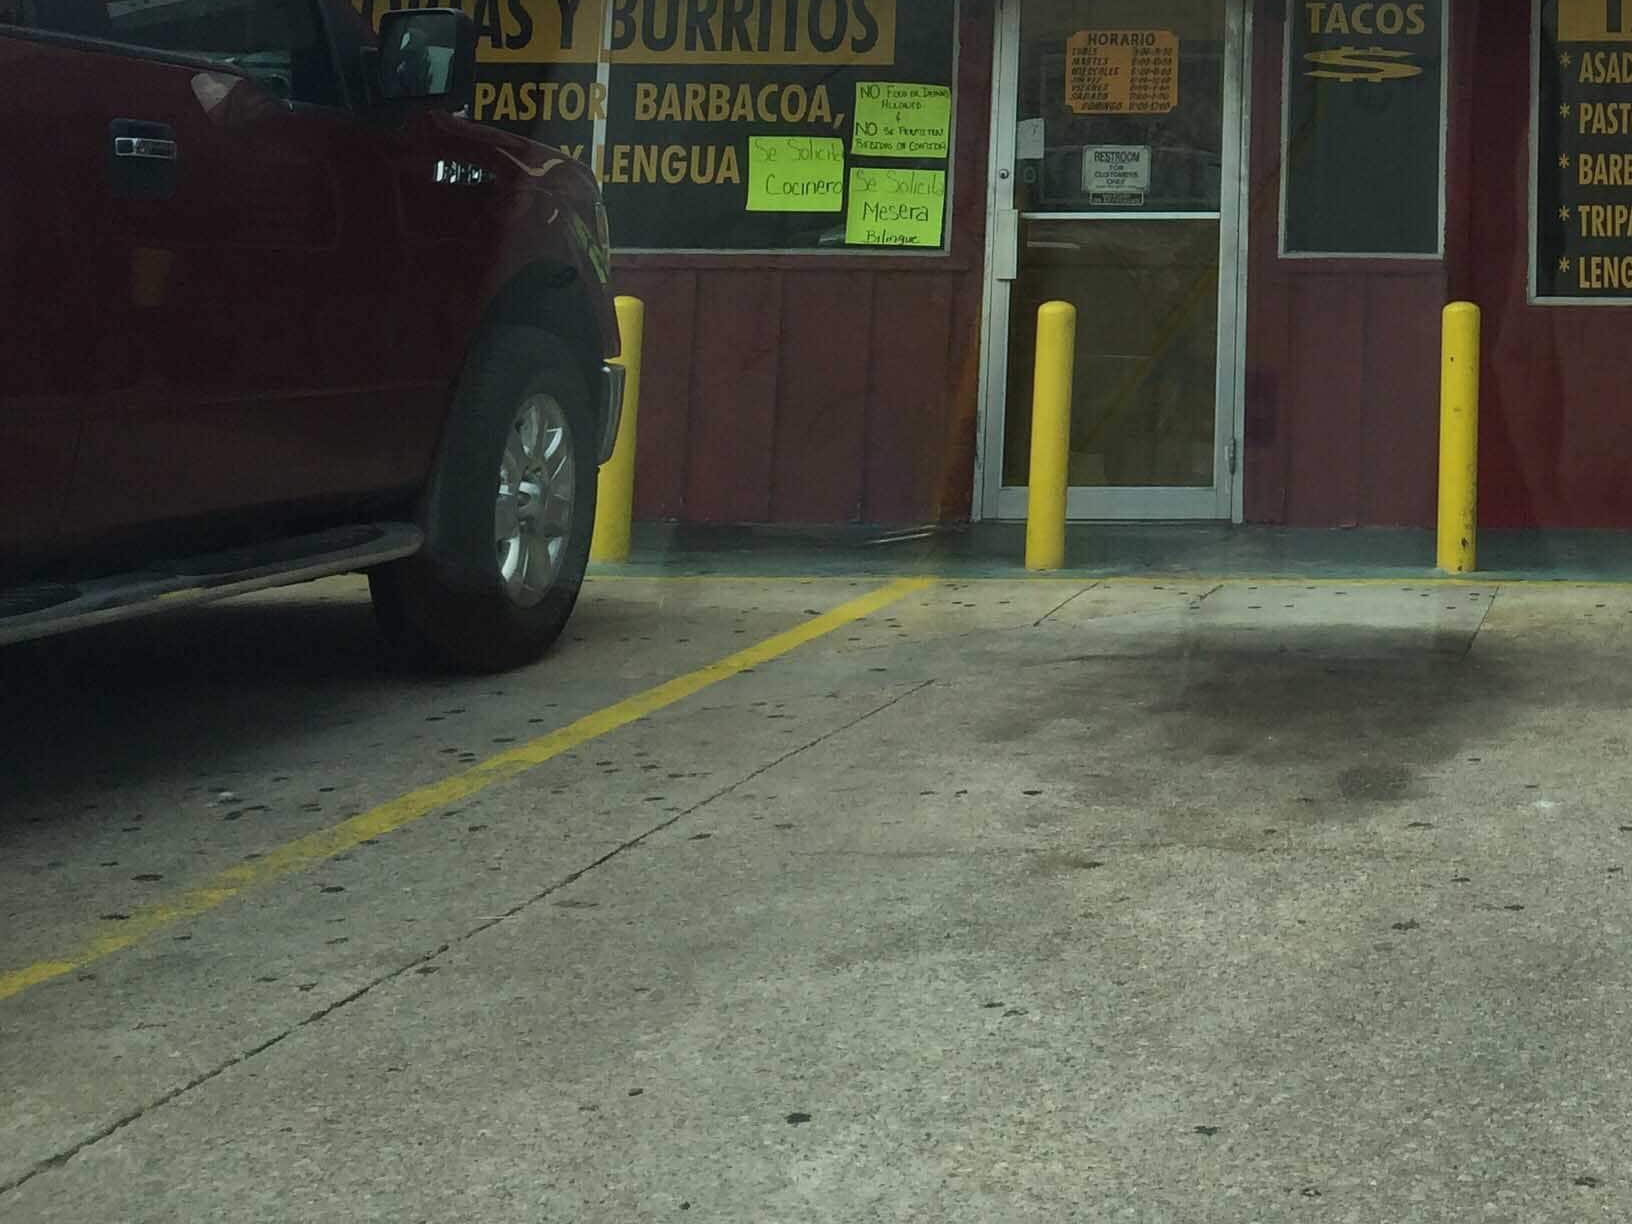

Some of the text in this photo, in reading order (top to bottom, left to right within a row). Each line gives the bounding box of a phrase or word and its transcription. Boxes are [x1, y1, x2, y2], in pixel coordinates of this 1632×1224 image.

[1304, 1, 1425, 36] TACOS
[1087, 32, 1156, 46] HORARIO
[860, 84, 880, 99] NO
[474, 82, 846, 129] PASTOR BARBACOA,
[855, 121, 878, 136] NO
[754, 138, 777, 162] Se
[1094, 151, 1140, 163] RESTROOM
[598, 143, 742, 185] LENGUA
[856, 168, 878, 193] Se
[862, 200, 929, 223] Mesera
